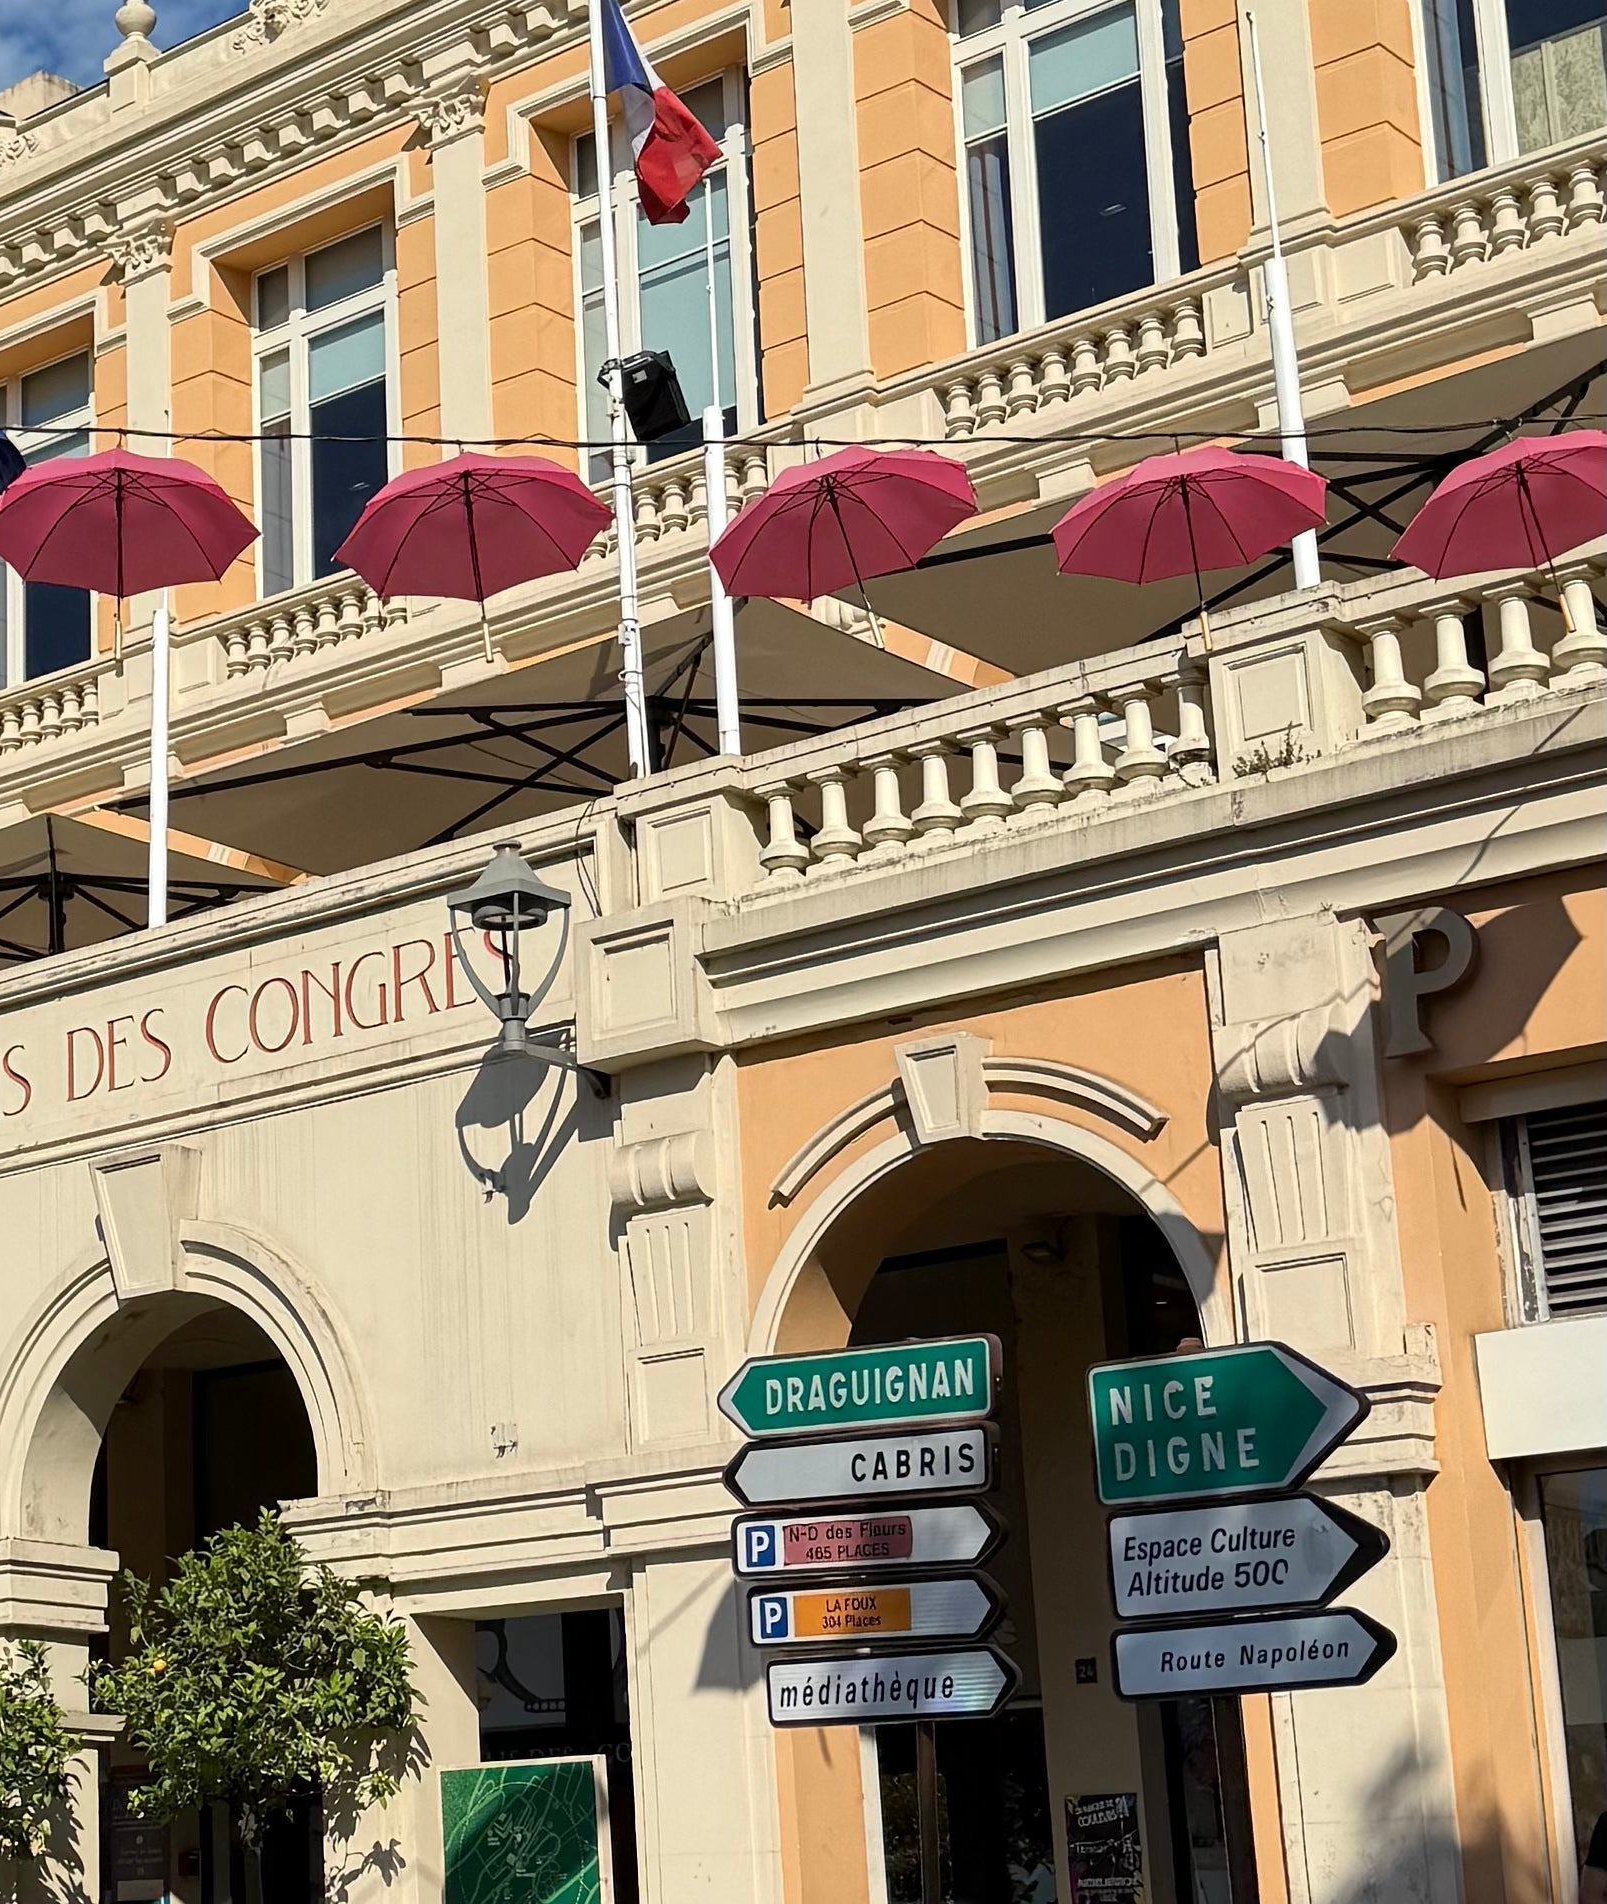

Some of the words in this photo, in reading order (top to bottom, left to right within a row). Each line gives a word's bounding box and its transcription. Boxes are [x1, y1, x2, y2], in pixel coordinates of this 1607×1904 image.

[67, 1009, 172, 1102] DES
[765, 1358, 974, 1415] DRAGUIGNAN
[1109, 1375, 1217, 1426] NICE
[851, 1443, 975, 1482] CABRIS
[1113, 1427, 1260, 1482] DIGNE
[789, 1526, 818, 1542] N-D
[826, 1525, 852, 1540] des
[837, 1543, 890, 1559] PLACES
[1123, 1536, 1202, 1566] Espace
[1210, 1526, 1295, 1553] Culture
[1127, 1565, 1225, 1597] Altitude
[825, 1599, 842, 1613] LA
[844, 1597, 877, 1611] FOUX
[845, 1614, 882, 1628] Places
[1160, 1650, 1226, 1673] Route
[1239, 1639, 1350, 1669] Napoléon
[780, 1670, 954, 1710] médiathèque
